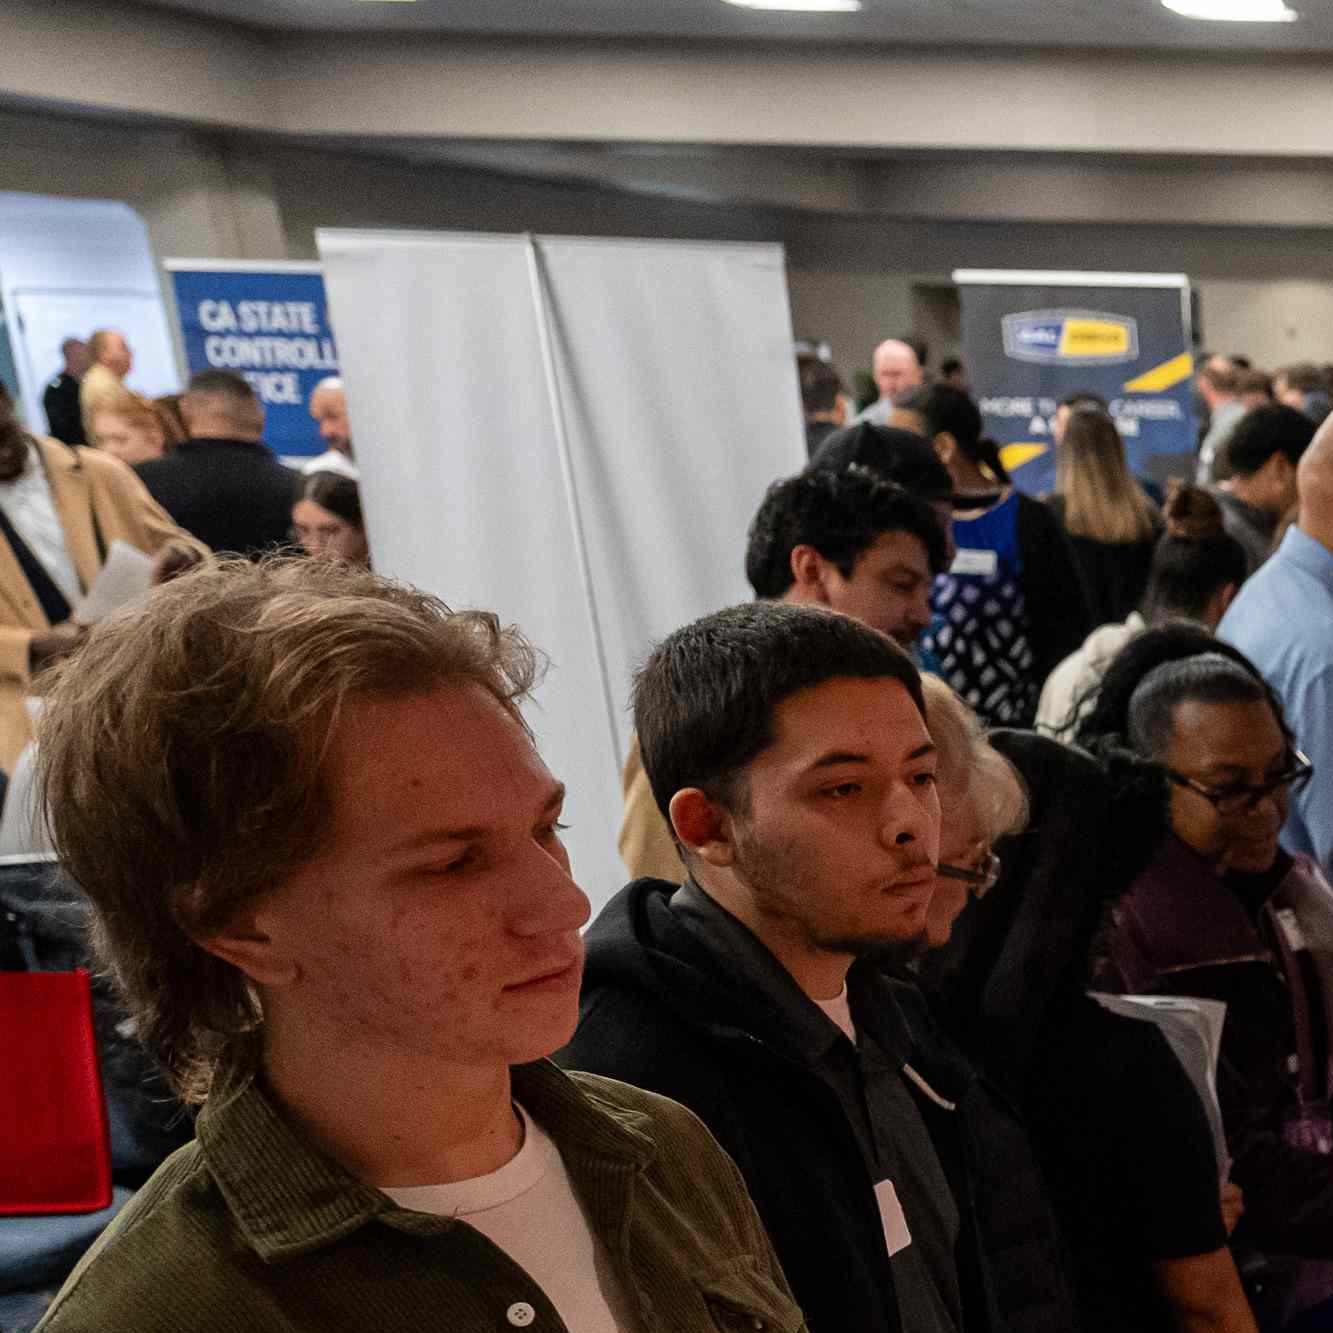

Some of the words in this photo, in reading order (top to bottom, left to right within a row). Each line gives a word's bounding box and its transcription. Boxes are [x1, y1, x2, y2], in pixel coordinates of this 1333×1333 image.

[198, 300, 238, 332] CA
[239, 300, 320, 334] STATE
[205, 335, 340, 370] CONTROLL
